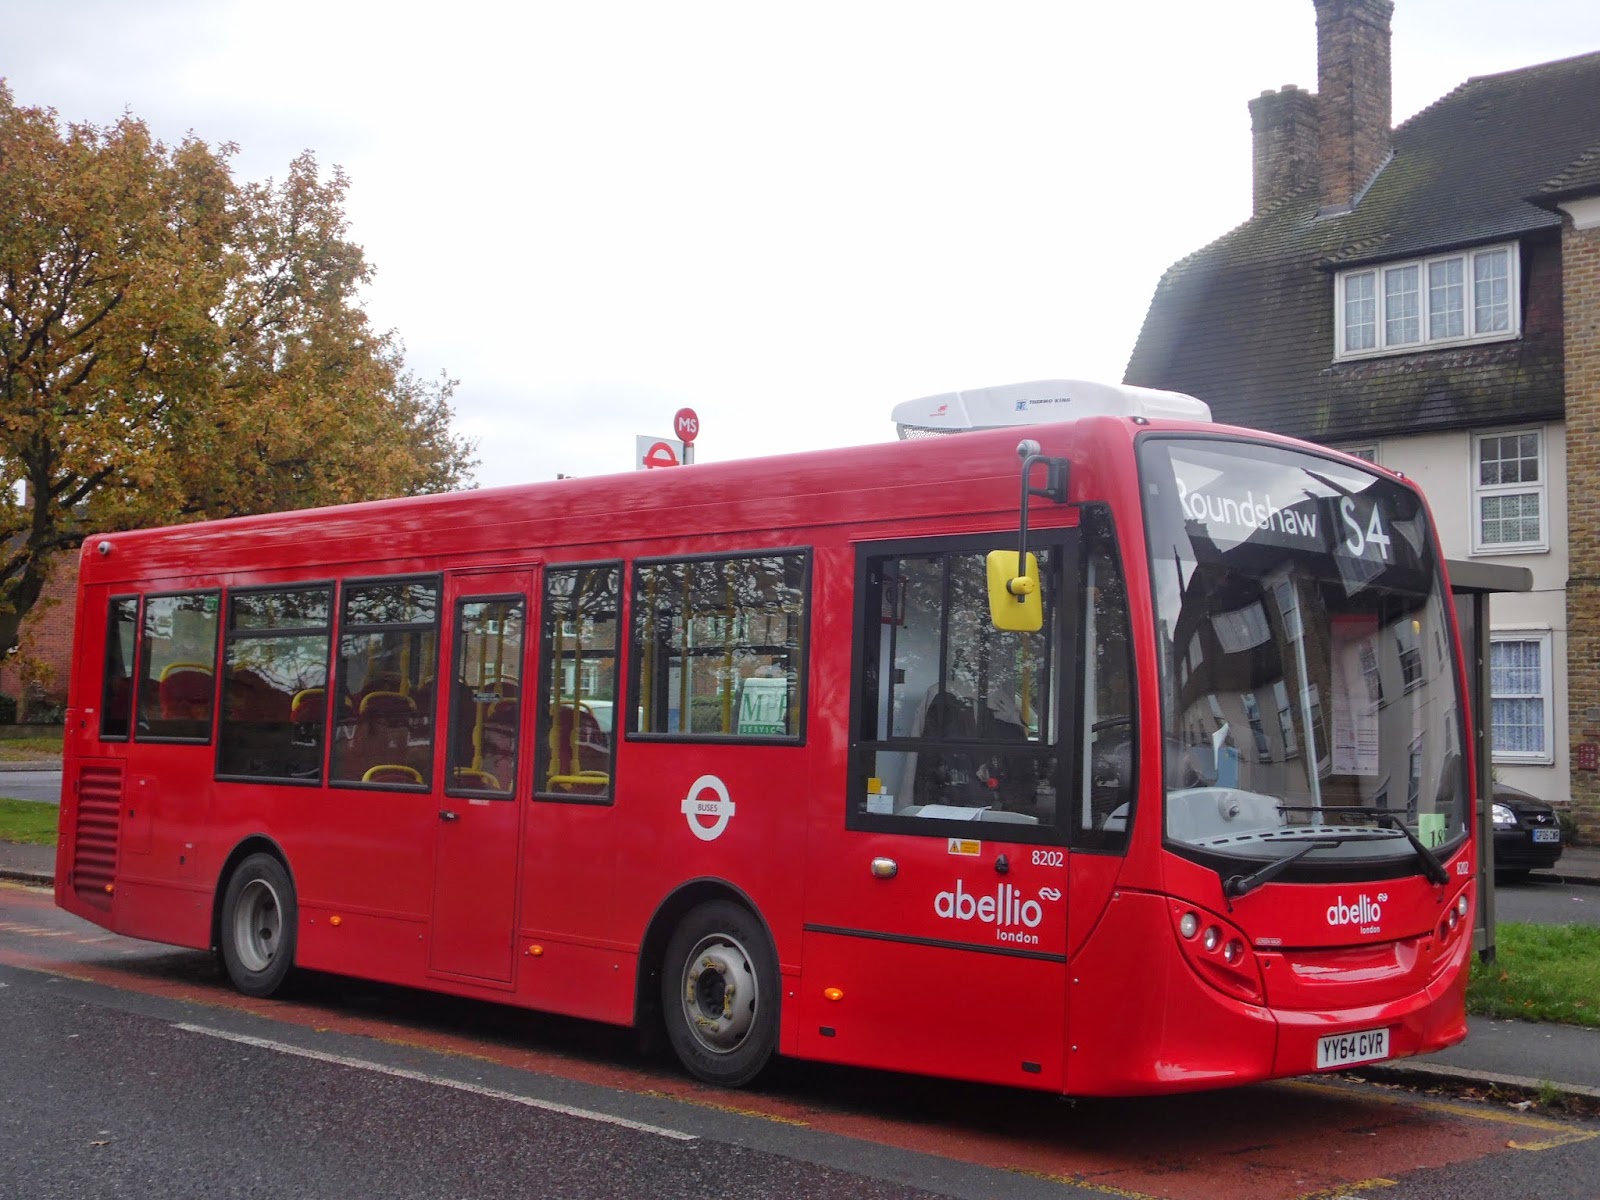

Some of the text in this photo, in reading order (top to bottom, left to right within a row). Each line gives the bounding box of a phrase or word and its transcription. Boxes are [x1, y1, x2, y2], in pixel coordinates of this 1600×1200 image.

[678, 416, 697, 433] MS
[1174, 477, 1317, 538] Roundshaw
[1339, 495, 1391, 560] S4
[697, 803, 718, 812] BUSES
[1031, 850, 1063, 867] 8202
[934, 879, 1042, 927] abellio
[1327, 894, 1381, 925] abellio
[996, 928, 1039, 944] london
[1360, 925, 1380, 934] london
[1324, 1032, 1383, 1062] YY64 GVR
